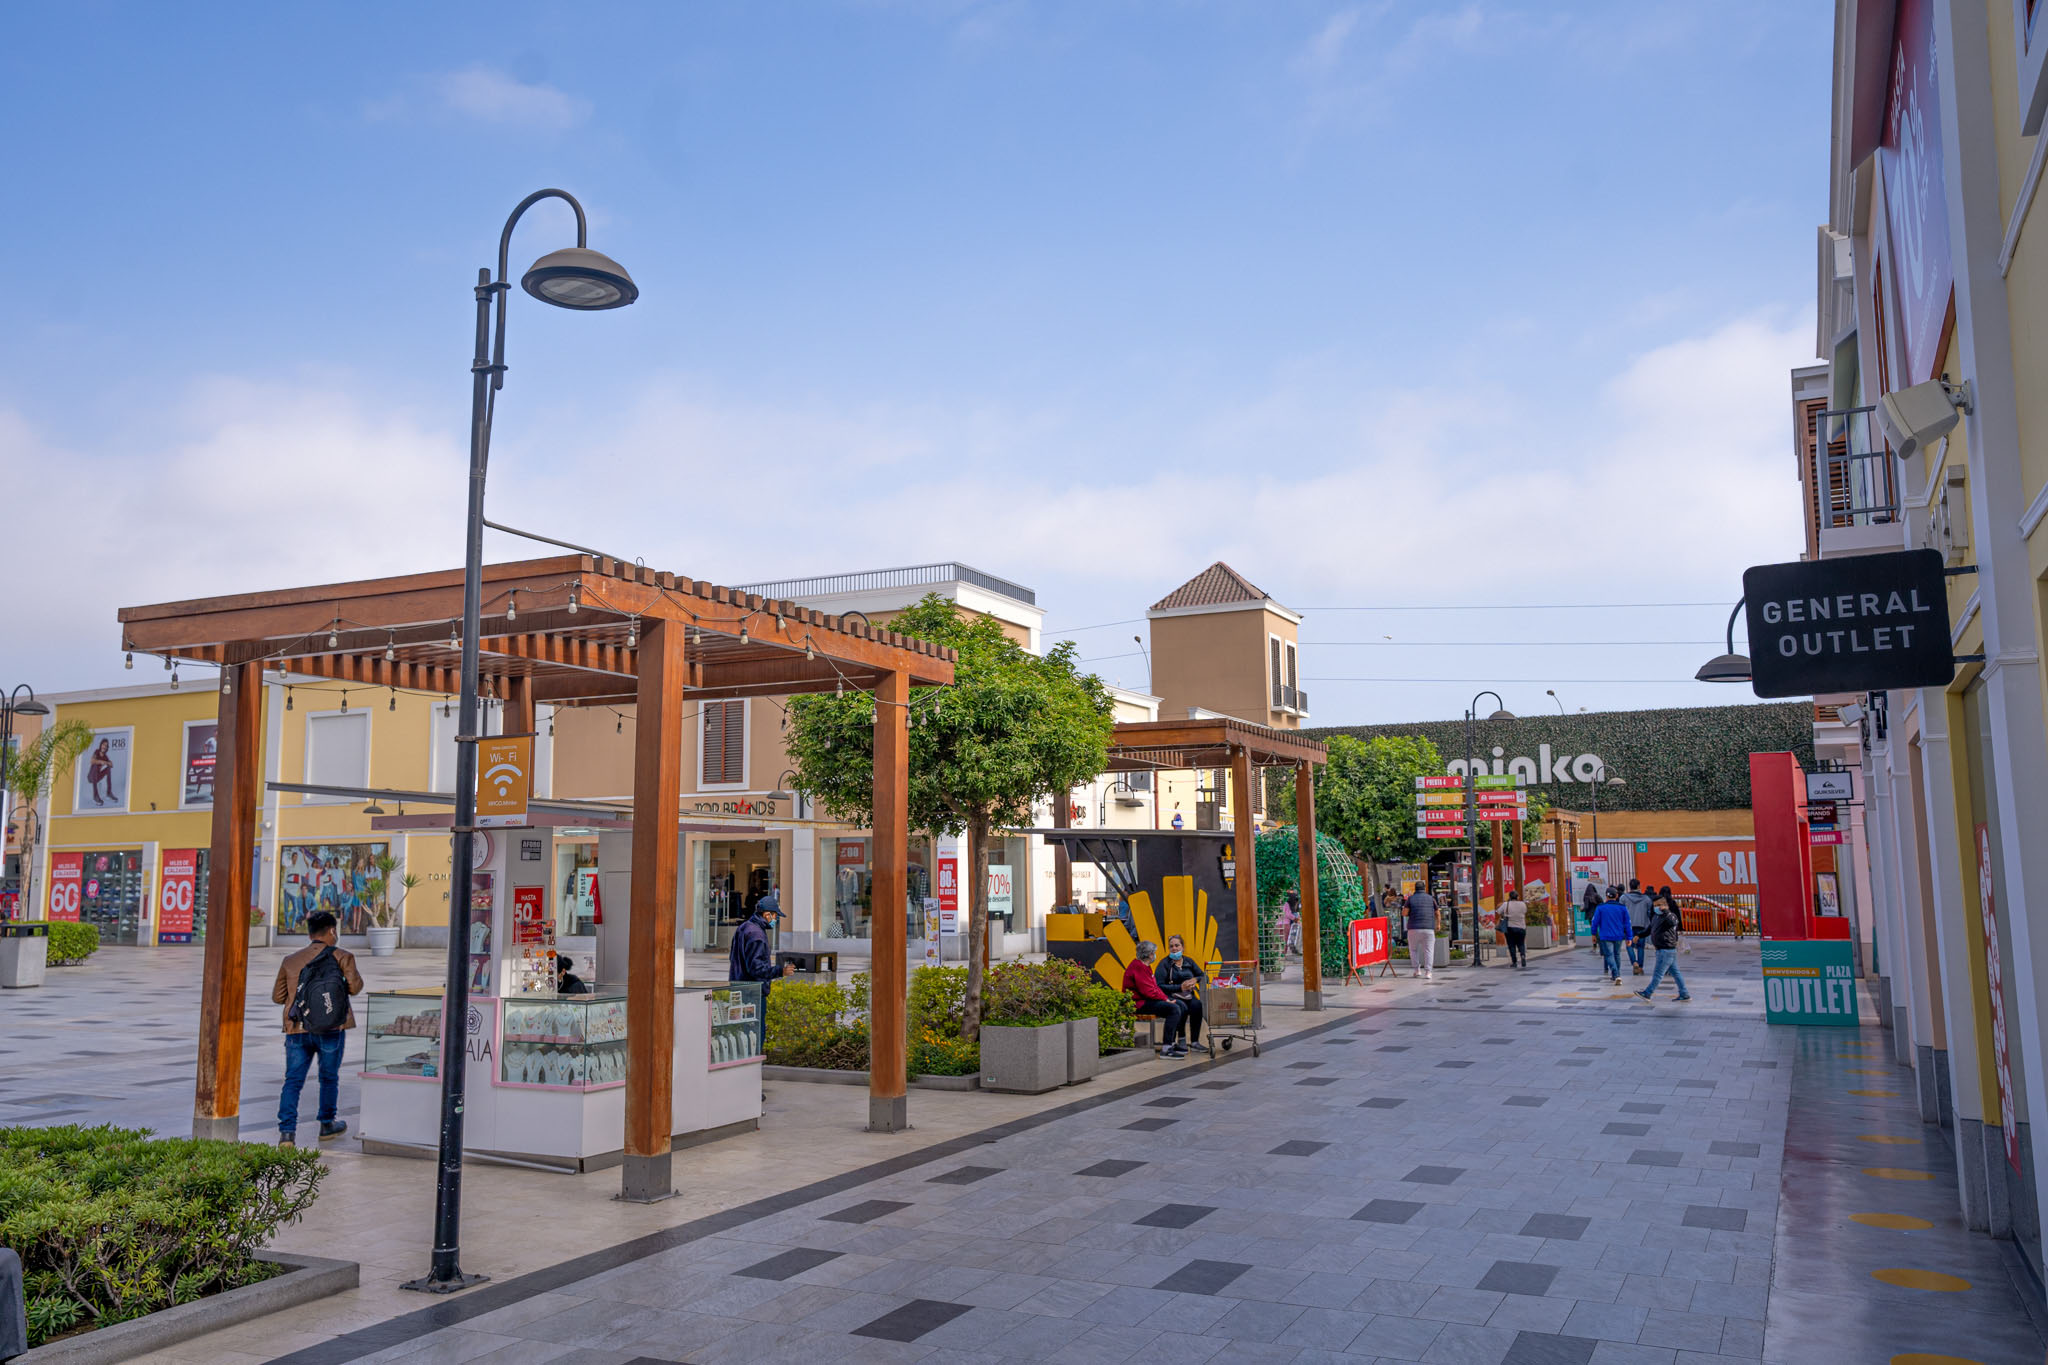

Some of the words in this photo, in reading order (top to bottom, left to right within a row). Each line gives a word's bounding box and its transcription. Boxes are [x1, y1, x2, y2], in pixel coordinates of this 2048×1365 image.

[1762, 589, 1930, 624] GENERAL
[1778, 624, 1915, 657] OUTLET
[111, 738, 126, 749] R18
[1447, 743, 1605, 785] minka
[987, 873, 1011, 895] 70%
[1401, 871, 1420, 880] ORO
[1825, 965, 1852, 977] PLAZA
[1767, 977, 1852, 1014] OUTLET
